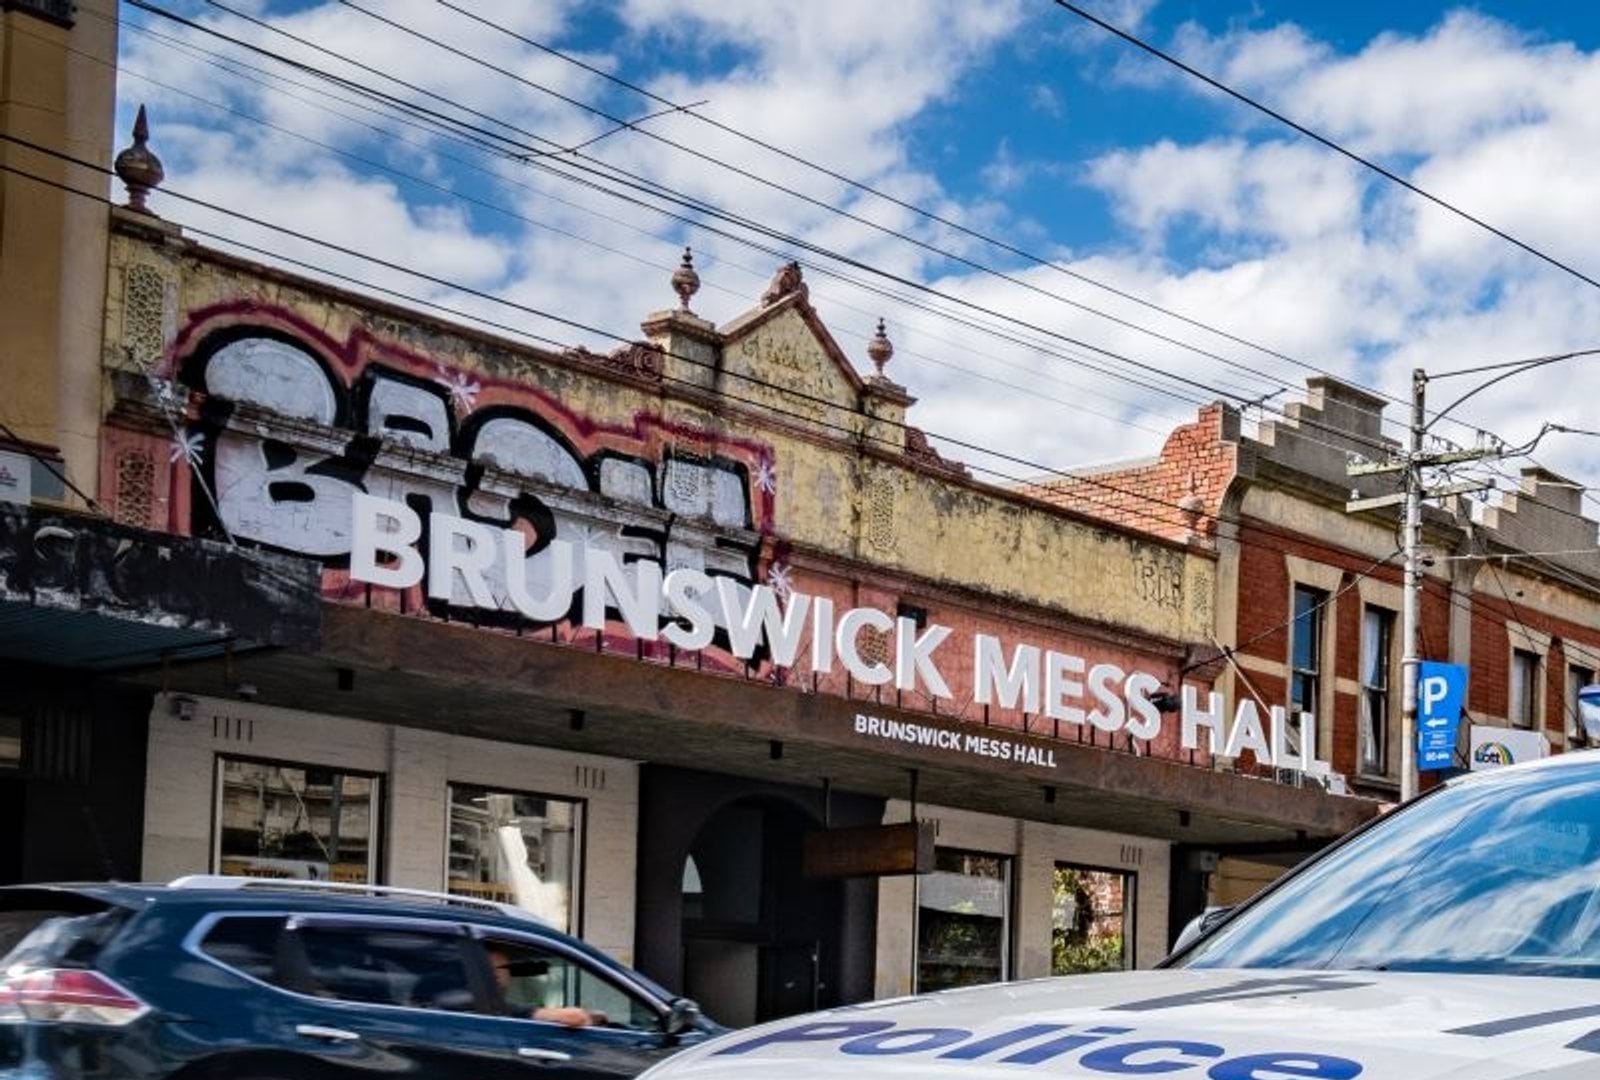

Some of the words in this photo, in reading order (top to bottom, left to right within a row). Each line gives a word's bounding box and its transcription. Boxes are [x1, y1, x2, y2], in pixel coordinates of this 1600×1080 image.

[350, 493, 953, 700] BRUNSWICK
[974, 632, 1162, 741] MESS
[1181, 685, 1329, 773] HALL
[1423, 676, 1448, 716] P
[855, 714, 961, 752] BRUNSWICK
[965, 736, 1012, 761] MESS
[1013, 743, 1057, 767] HALL
